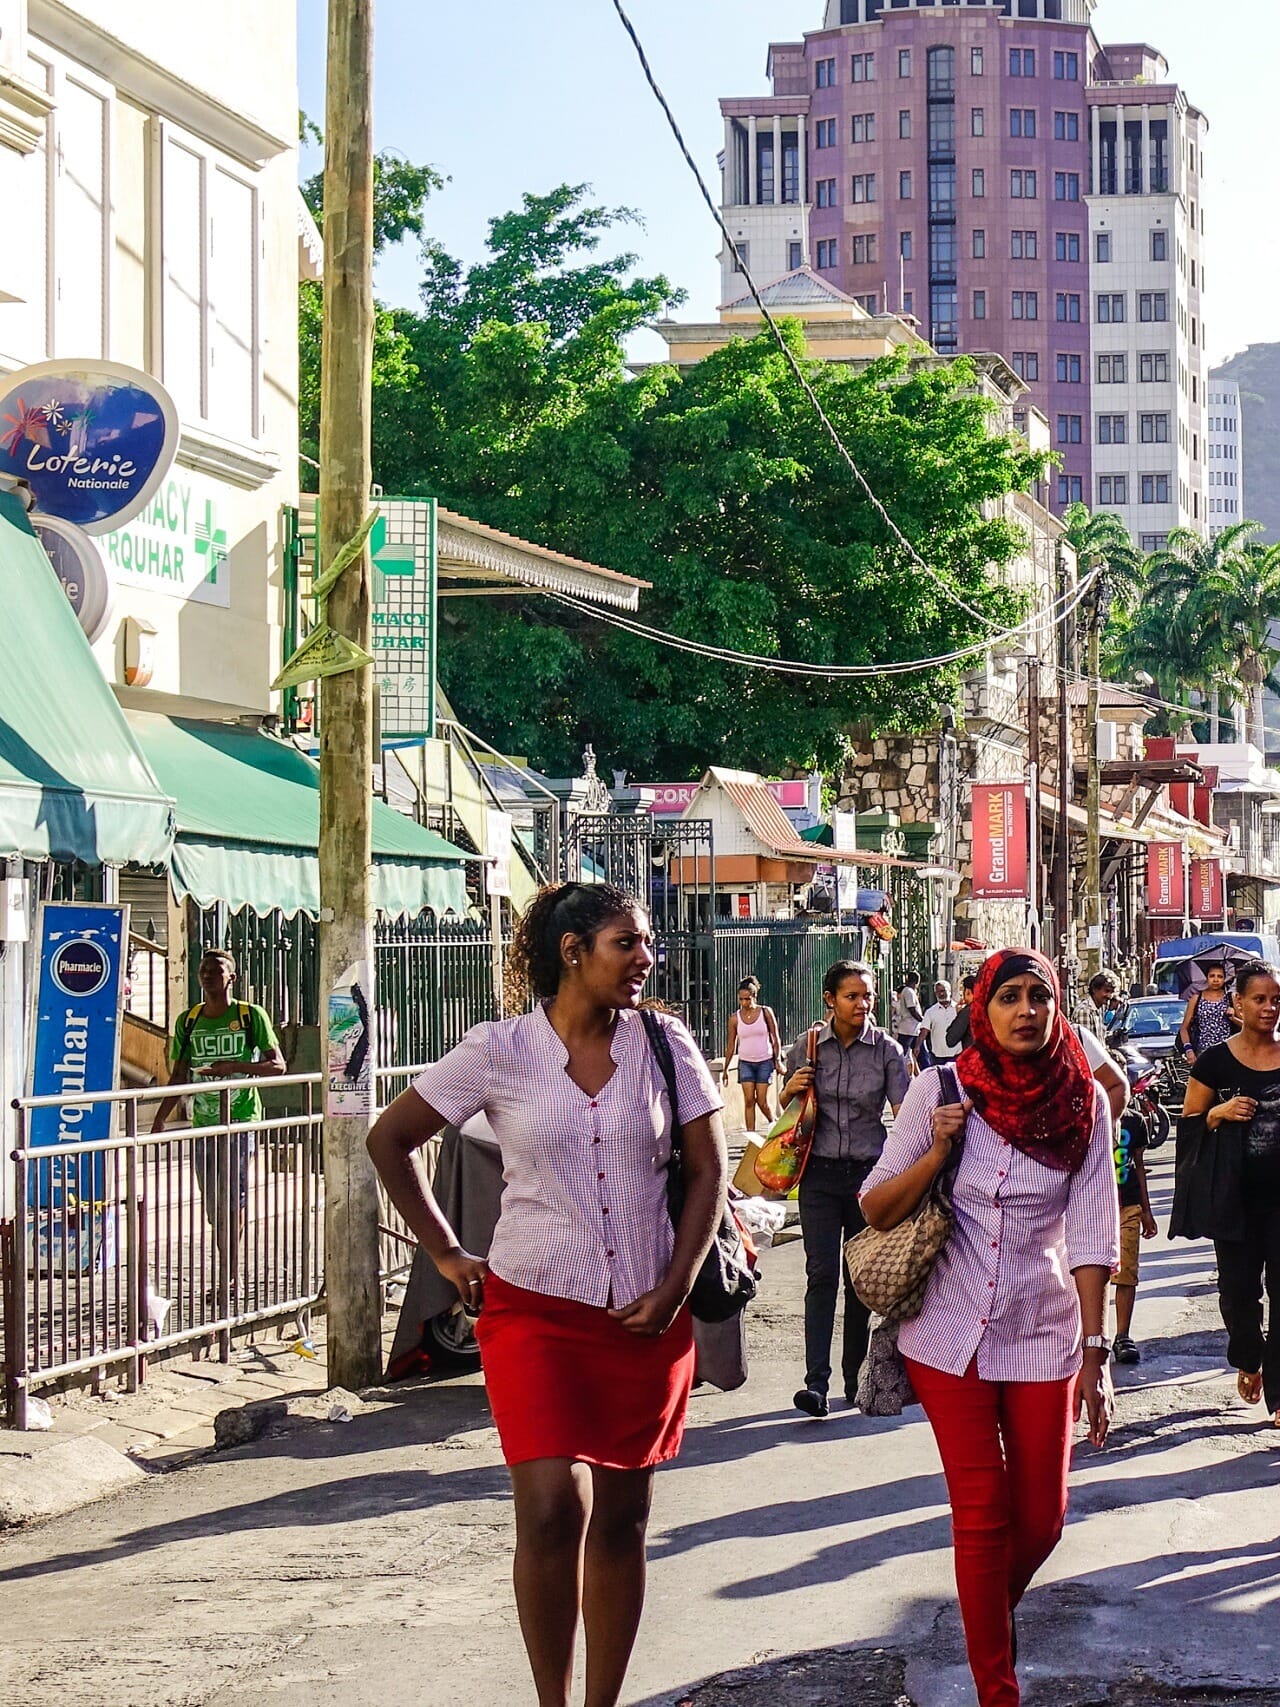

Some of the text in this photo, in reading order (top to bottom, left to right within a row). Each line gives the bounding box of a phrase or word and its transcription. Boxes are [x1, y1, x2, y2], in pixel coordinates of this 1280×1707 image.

[27, 444, 137, 477] Loterie
[67, 478, 130, 490] Nationale
[97, 531, 184, 583] RQUHAR
[371, 612, 426, 625] MACY
[371, 636, 425, 648] UHAR
[988, 791, 1005, 884] GrandMARK
[1158, 847, 1169, 906] GrandMARK
[1200, 862, 1210, 912] GrandMARK
[59, 960, 102, 973] Pharmacie
[190, 1032, 246, 1057] USION
